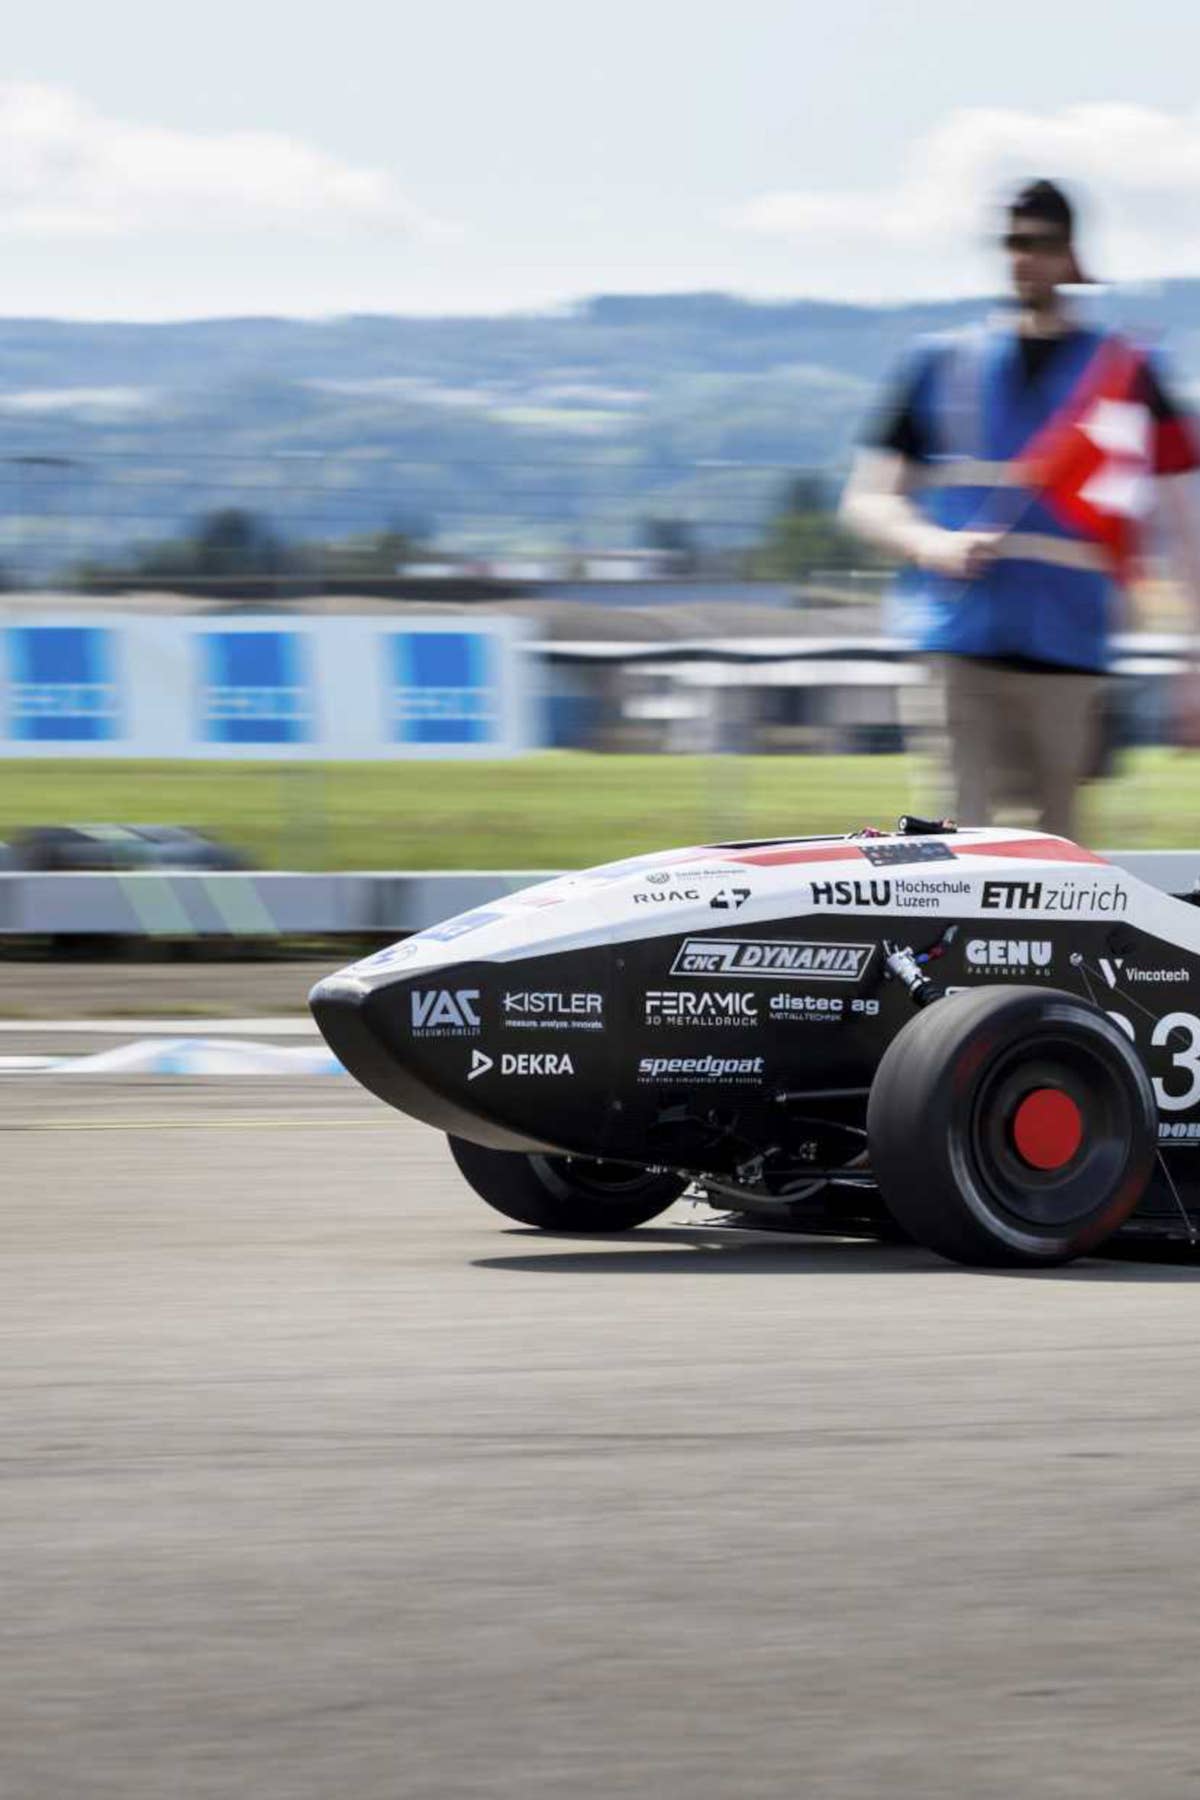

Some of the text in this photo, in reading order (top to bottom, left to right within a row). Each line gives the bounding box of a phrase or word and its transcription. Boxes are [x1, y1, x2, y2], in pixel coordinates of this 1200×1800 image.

[633, 890, 700, 903] RUAG
[811, 880, 890, 906] HSLU
[895, 880, 971, 895] Hochschule
[981, 881, 1128, 912] ETH zürich
[895, 895, 940, 908] Luzern
[682, 946, 865, 971] CNC DYNAMIX
[965, 939, 1052, 966] GENU
[1126, 968, 1190, 982] Vincotech
[411, 990, 480, 1027] VAC
[503, 992, 602, 1013] KISTLER
[646, 991, 758, 1016] FERAMIC
[769, 993, 880, 1015] distec ag
[646, 1015, 758, 1026] 3D METALLDRUCK
[501, 1053, 574, 1076] DEKRA
[639, 1055, 764, 1076] speedgoat
